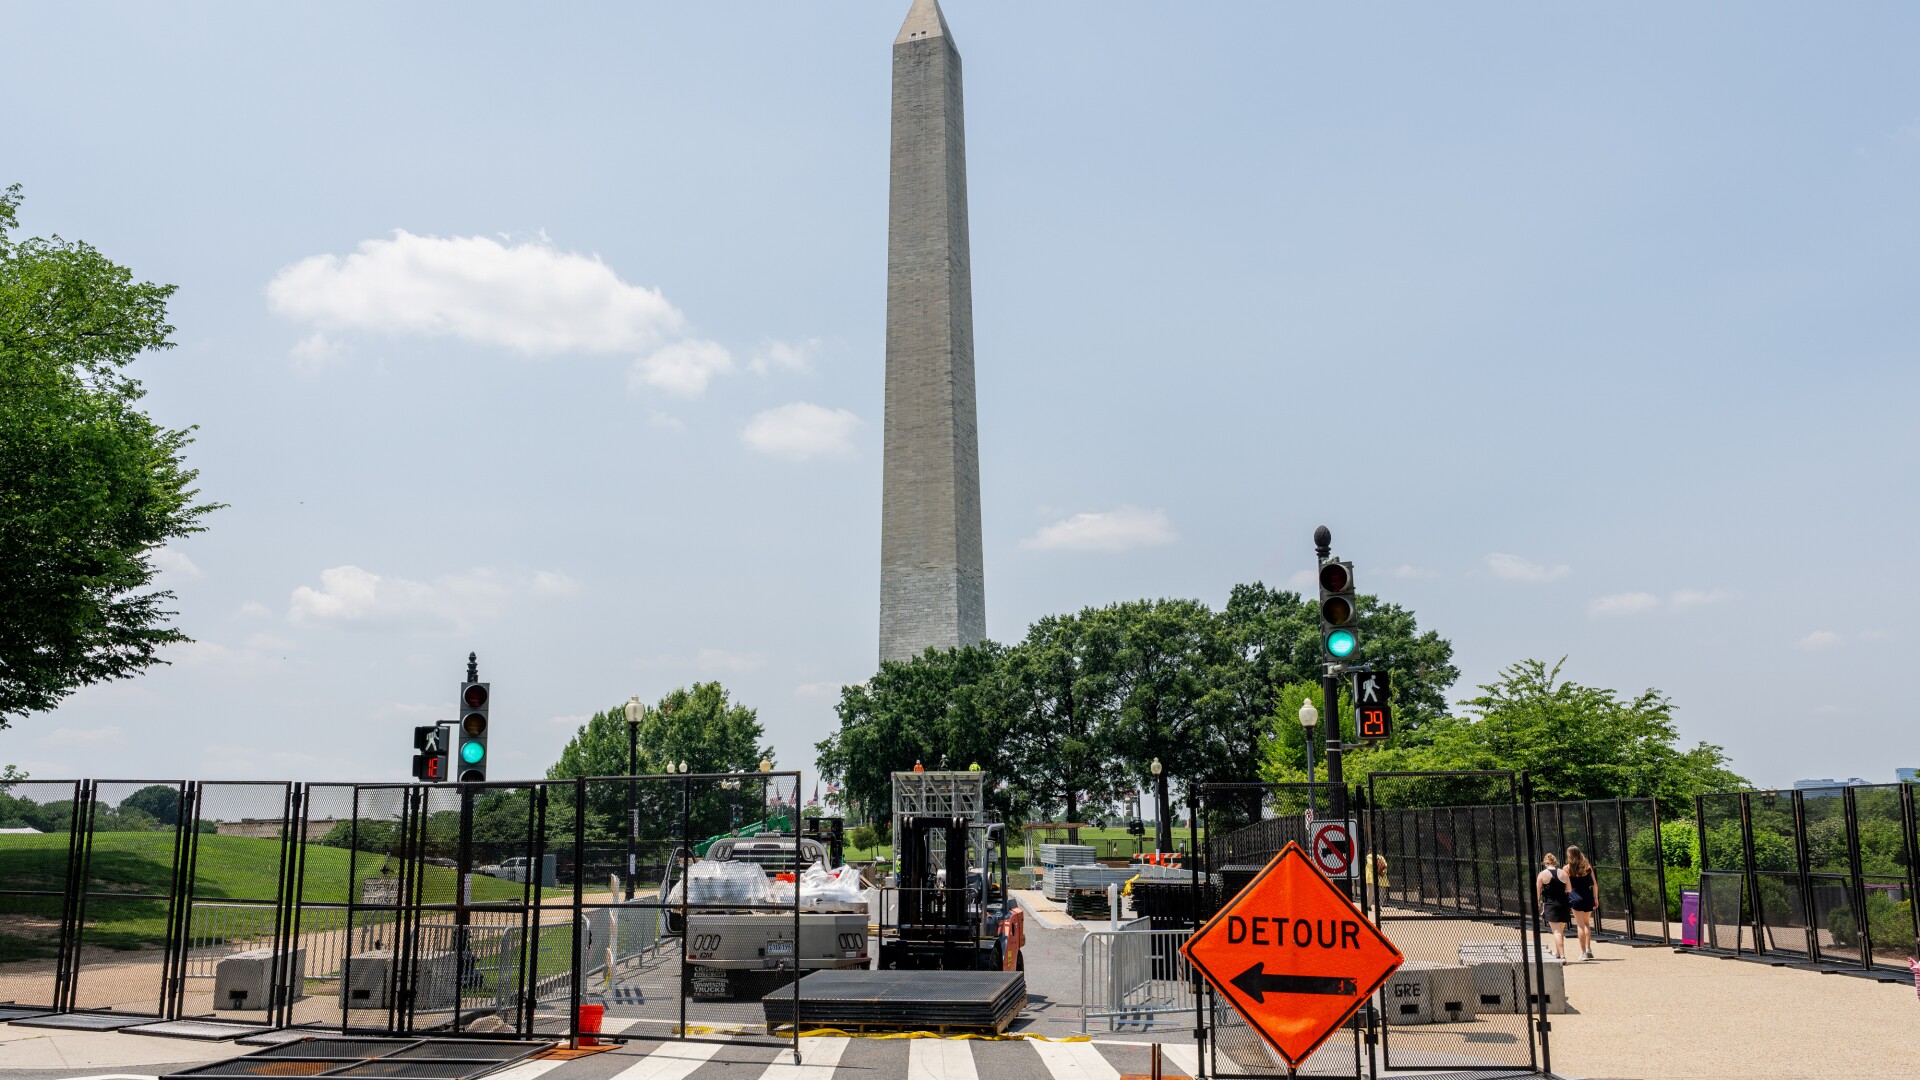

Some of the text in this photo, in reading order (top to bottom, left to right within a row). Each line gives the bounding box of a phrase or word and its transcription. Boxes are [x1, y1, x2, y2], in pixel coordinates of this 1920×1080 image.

[1364, 710, 1384, 735] 29
[363, 883, 404, 893] SIDEWA
[1228, 916, 1360, 949] DETOUR
[1394, 983, 1421, 997] GRE
